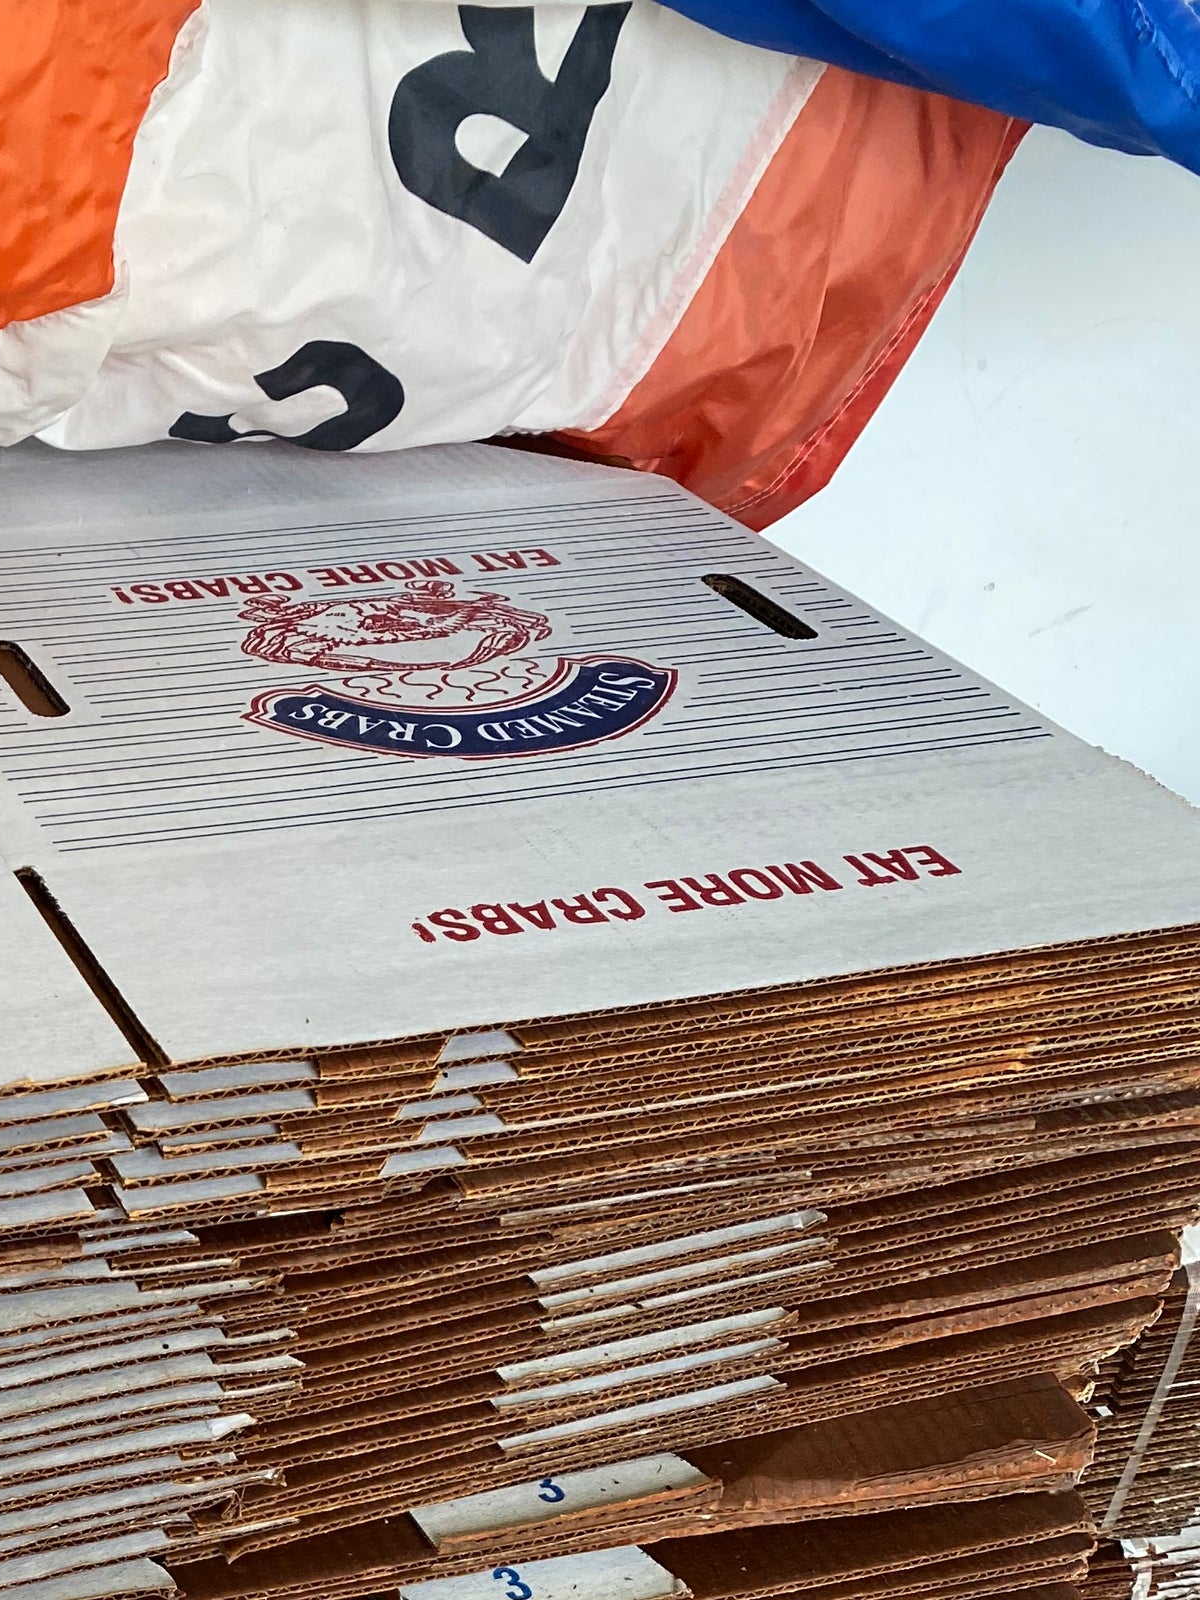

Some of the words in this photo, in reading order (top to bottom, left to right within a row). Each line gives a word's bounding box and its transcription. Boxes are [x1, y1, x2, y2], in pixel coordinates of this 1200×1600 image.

[306, 557, 465, 585] MORE
[468, 548, 562, 572] EAT
[112, 571, 304, 605] CRABS!
[290, 702, 463, 750] CRABS
[478, 672, 658, 742] STEAMED
[643, 860, 844, 912] MORE
[842, 845, 963, 887] EAT
[411, 886, 647, 943] CRABS!
[492, 1567, 533, 1600] 3
